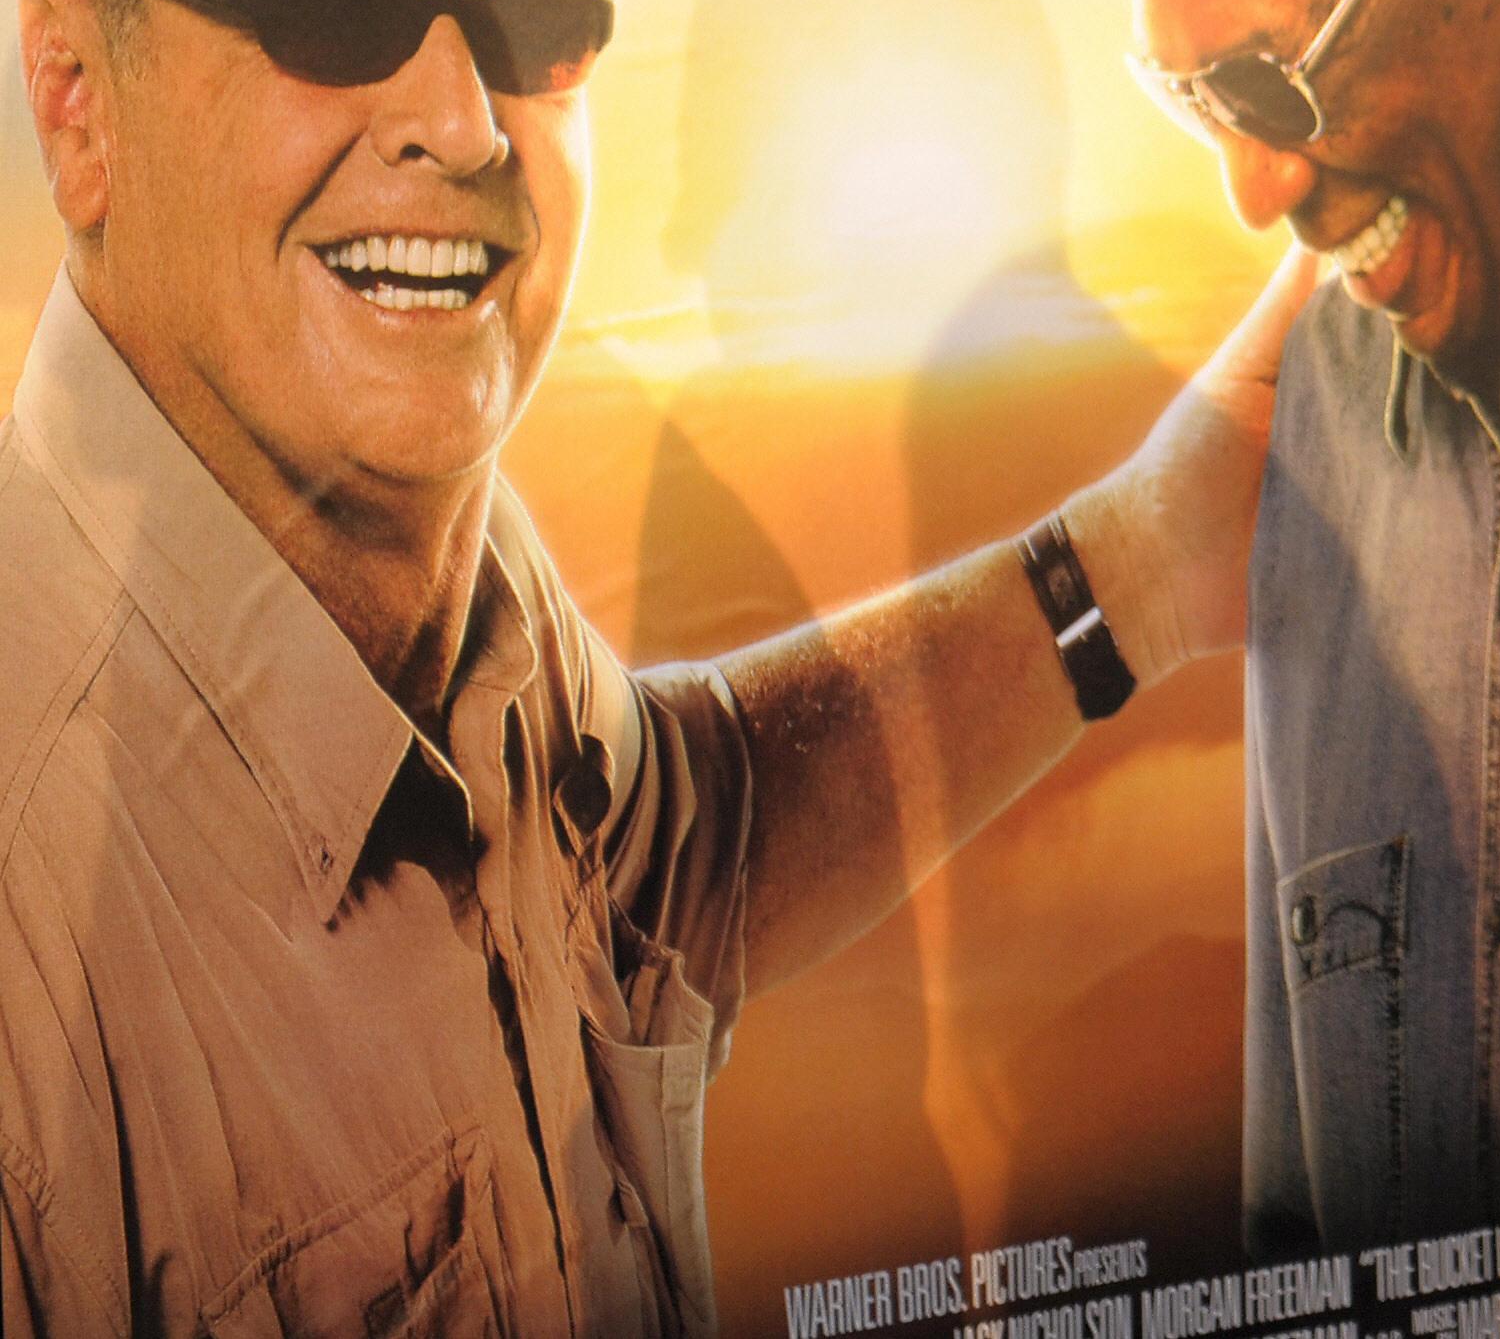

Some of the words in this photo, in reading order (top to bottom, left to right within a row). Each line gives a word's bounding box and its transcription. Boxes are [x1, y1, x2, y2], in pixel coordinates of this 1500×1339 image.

[783, 1269, 894, 1339] WARNER
[896, 1256, 968, 1325] BROS.
[969, 1234, 1074, 1310] PICTURES
[1072, 1237, 1148, 1290] PRESENTS
[1140, 1273, 1243, 1339] MORGAN
[1244, 1253, 1352, 1325] FREEMAN
[1416, 1225, 1495, 1295] BUCKET
